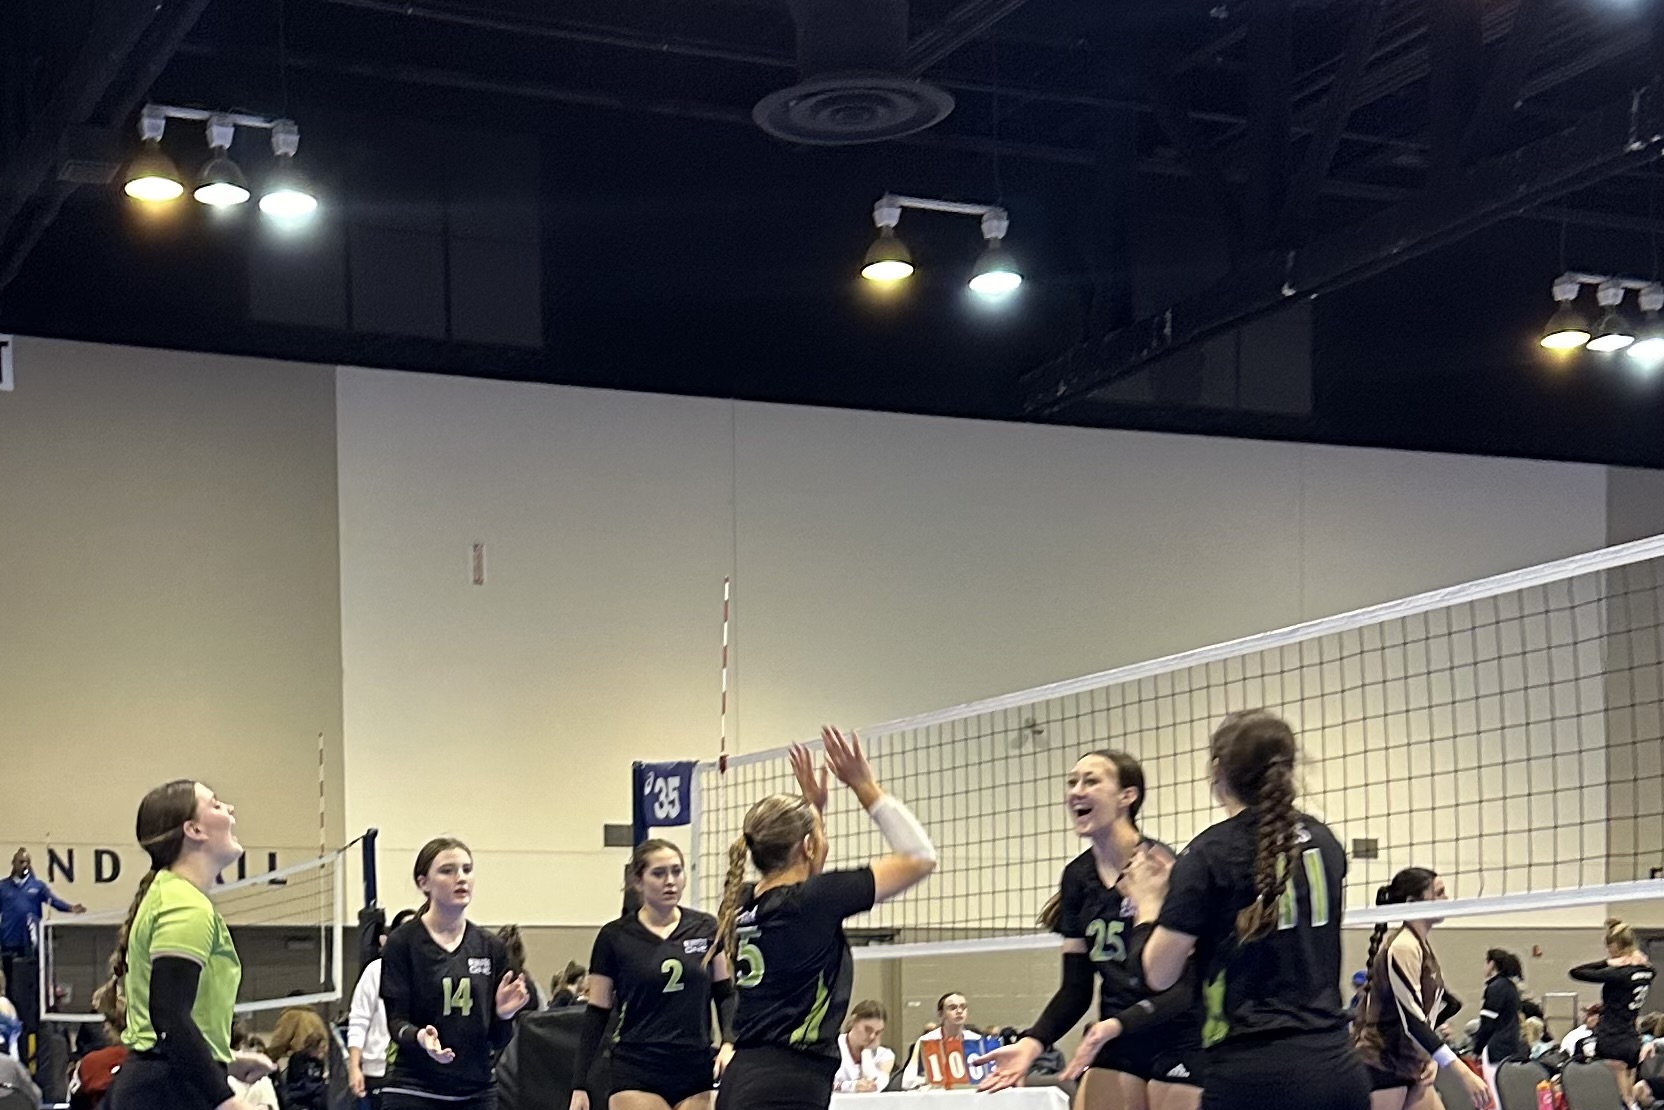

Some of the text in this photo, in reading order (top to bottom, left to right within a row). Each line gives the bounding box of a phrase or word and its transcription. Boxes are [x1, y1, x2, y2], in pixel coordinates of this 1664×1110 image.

[653, 775, 681, 819] 35
[1085, 918, 1127, 962] 25
[661, 958, 685, 993] 2
[442, 977, 473, 1016] 14
